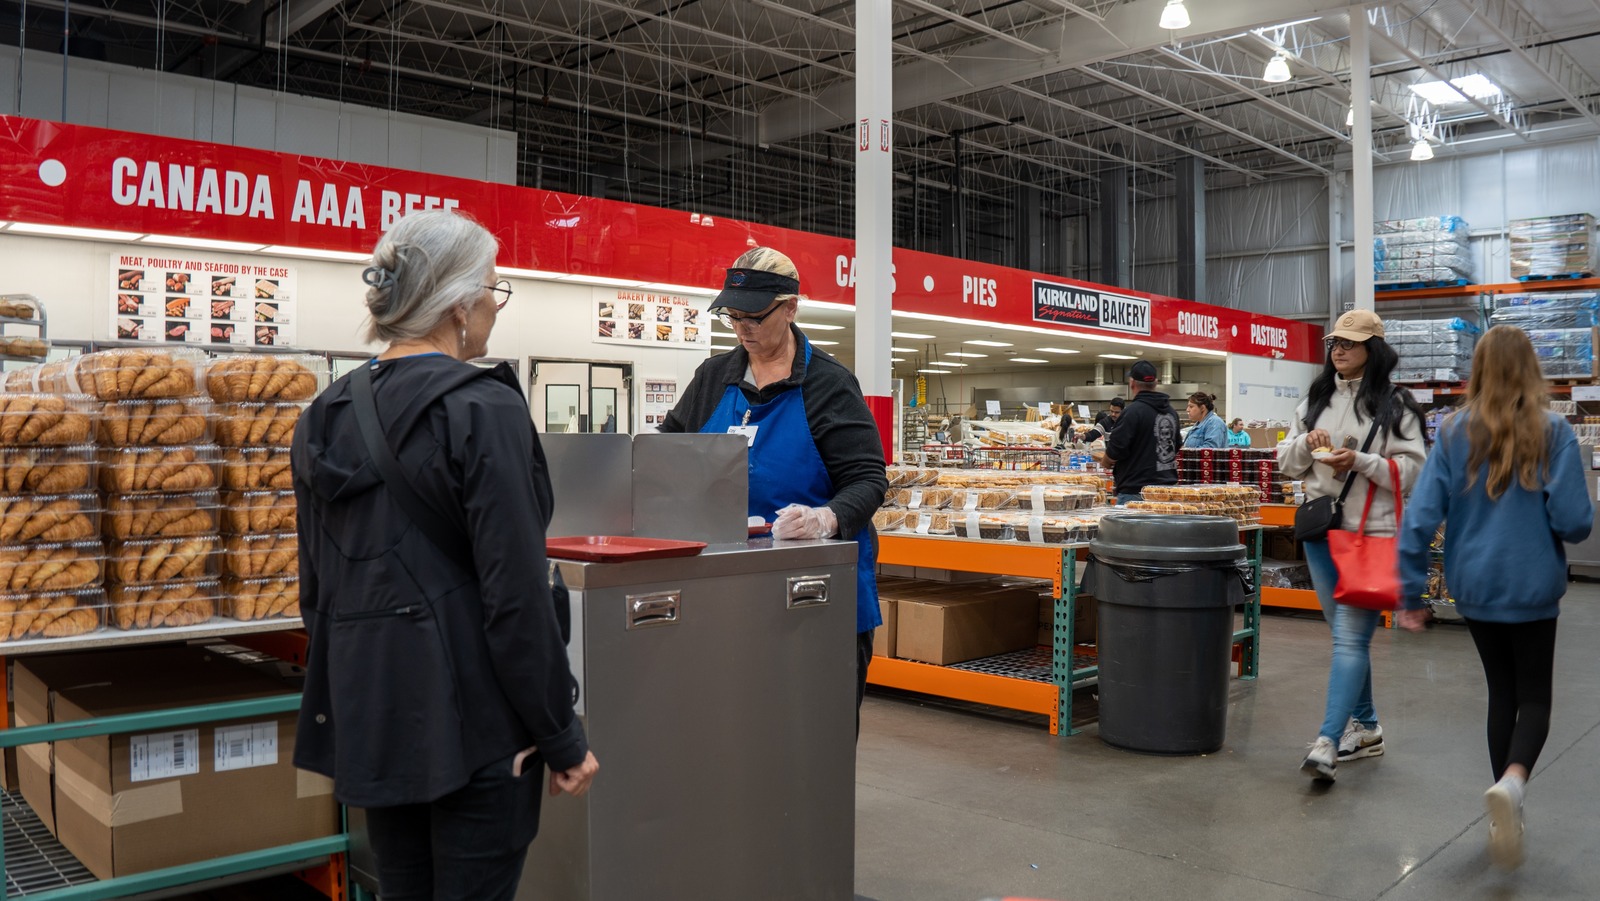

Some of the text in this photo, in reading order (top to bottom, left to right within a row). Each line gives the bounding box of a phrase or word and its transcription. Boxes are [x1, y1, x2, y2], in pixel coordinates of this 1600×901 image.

[111, 156, 275, 220] CANADA
[290, 179, 366, 230] AAA
[120, 256, 289, 278] MEAT, POULTRY AND SEAFOOD BY THE CASE
[617, 290, 690, 306] BAKERY BY THE CASE
[962, 275, 997, 308] PIES
[1038, 287, 1098, 313] KIRKLAND
[1038, 304, 1098, 321] Signature
[1102, 298, 1147, 329] BAKERY
[1177, 310, 1219, 339] COOKIES
[1250, 323, 1288, 349] PASTRIES
